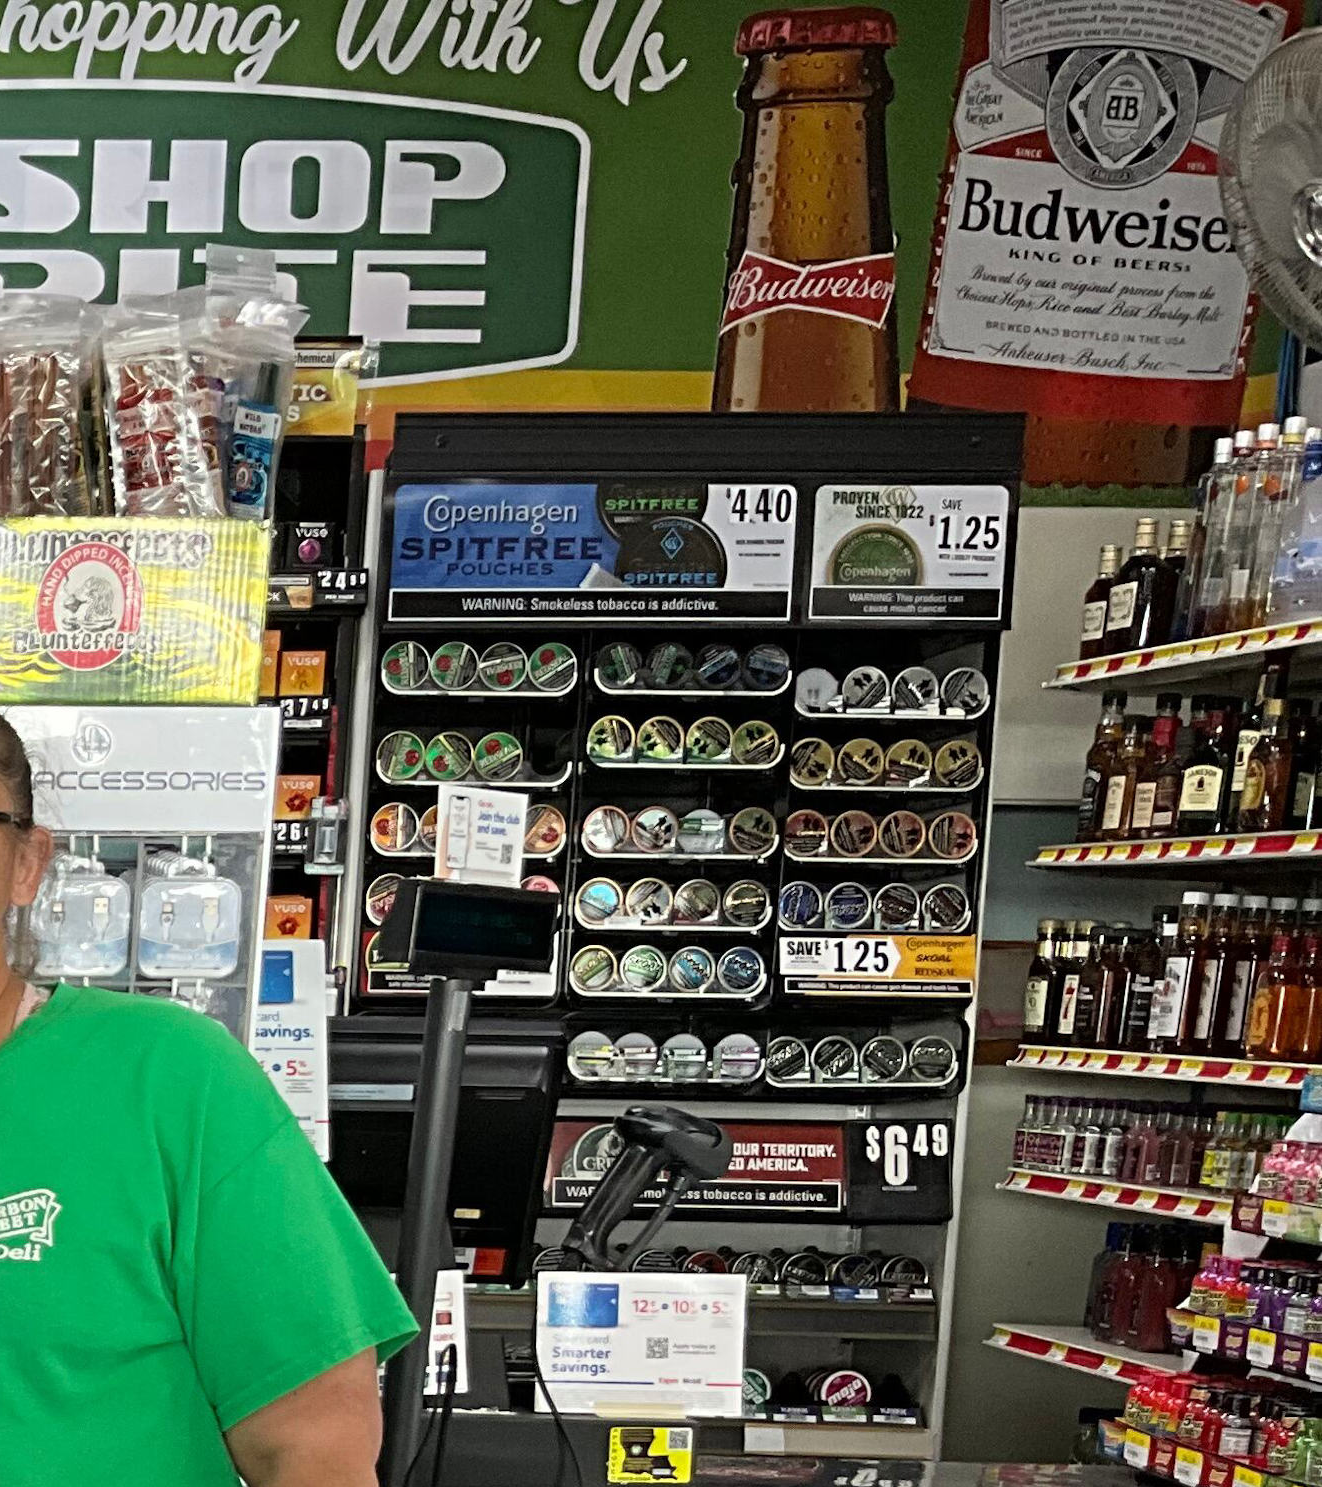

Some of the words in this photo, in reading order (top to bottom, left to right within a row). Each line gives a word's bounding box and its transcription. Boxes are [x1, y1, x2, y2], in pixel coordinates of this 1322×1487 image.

[336, 0, 544, 97] With
[580, 0, 688, 105] Us
[1009, 248, 1061, 263] KING
[1073, 254, 1101, 266] OF
[729, 263, 896, 309] Budweiser
[986, 320, 1030, 334] BREWED
[1034, 326, 1058, 336] AND
[1063, 328, 1119, 341] BOTTLED
[1123, 334, 1135, 343] IN
[1139, 334, 1160, 344] THE
[1164, 336, 1185, 345] USA
[605, 499, 699, 511] SPITFREE
[833, 491, 880, 504] PROVEN
[942, 499, 963, 511] SAVE
[423, 495, 578, 537] Copenhagen
[856, 506, 890, 518] SINCE
[399, 537, 603, 561] SPITFREE
[447, 561, 554, 577] POUCHES
[839, 563, 911, 583] Copenhagen
[623, 572, 717, 585] SPITFREE
[462, 598, 527, 611] WARNING:
[531, 599, 594, 611] Smokeless
[597, 599, 645, 611] tobacco
[648, 600, 658, 610] is
[31, 771, 266, 792] ACCESSORIES
[787, 941, 821, 956] SAVE
[916, 953, 952, 963] SKOAL
[762, 1143, 836, 1158] TERRITORY.
[747, 1159, 808, 1172] AMERICA.
[703, 1187, 752, 1202] tobacco
[755, 1189, 766, 1201] is
[769, 1188, 827, 1202] addictive.
[551, 1347, 610, 1360] Smarter
[551, 1361, 611, 1375] savings.
